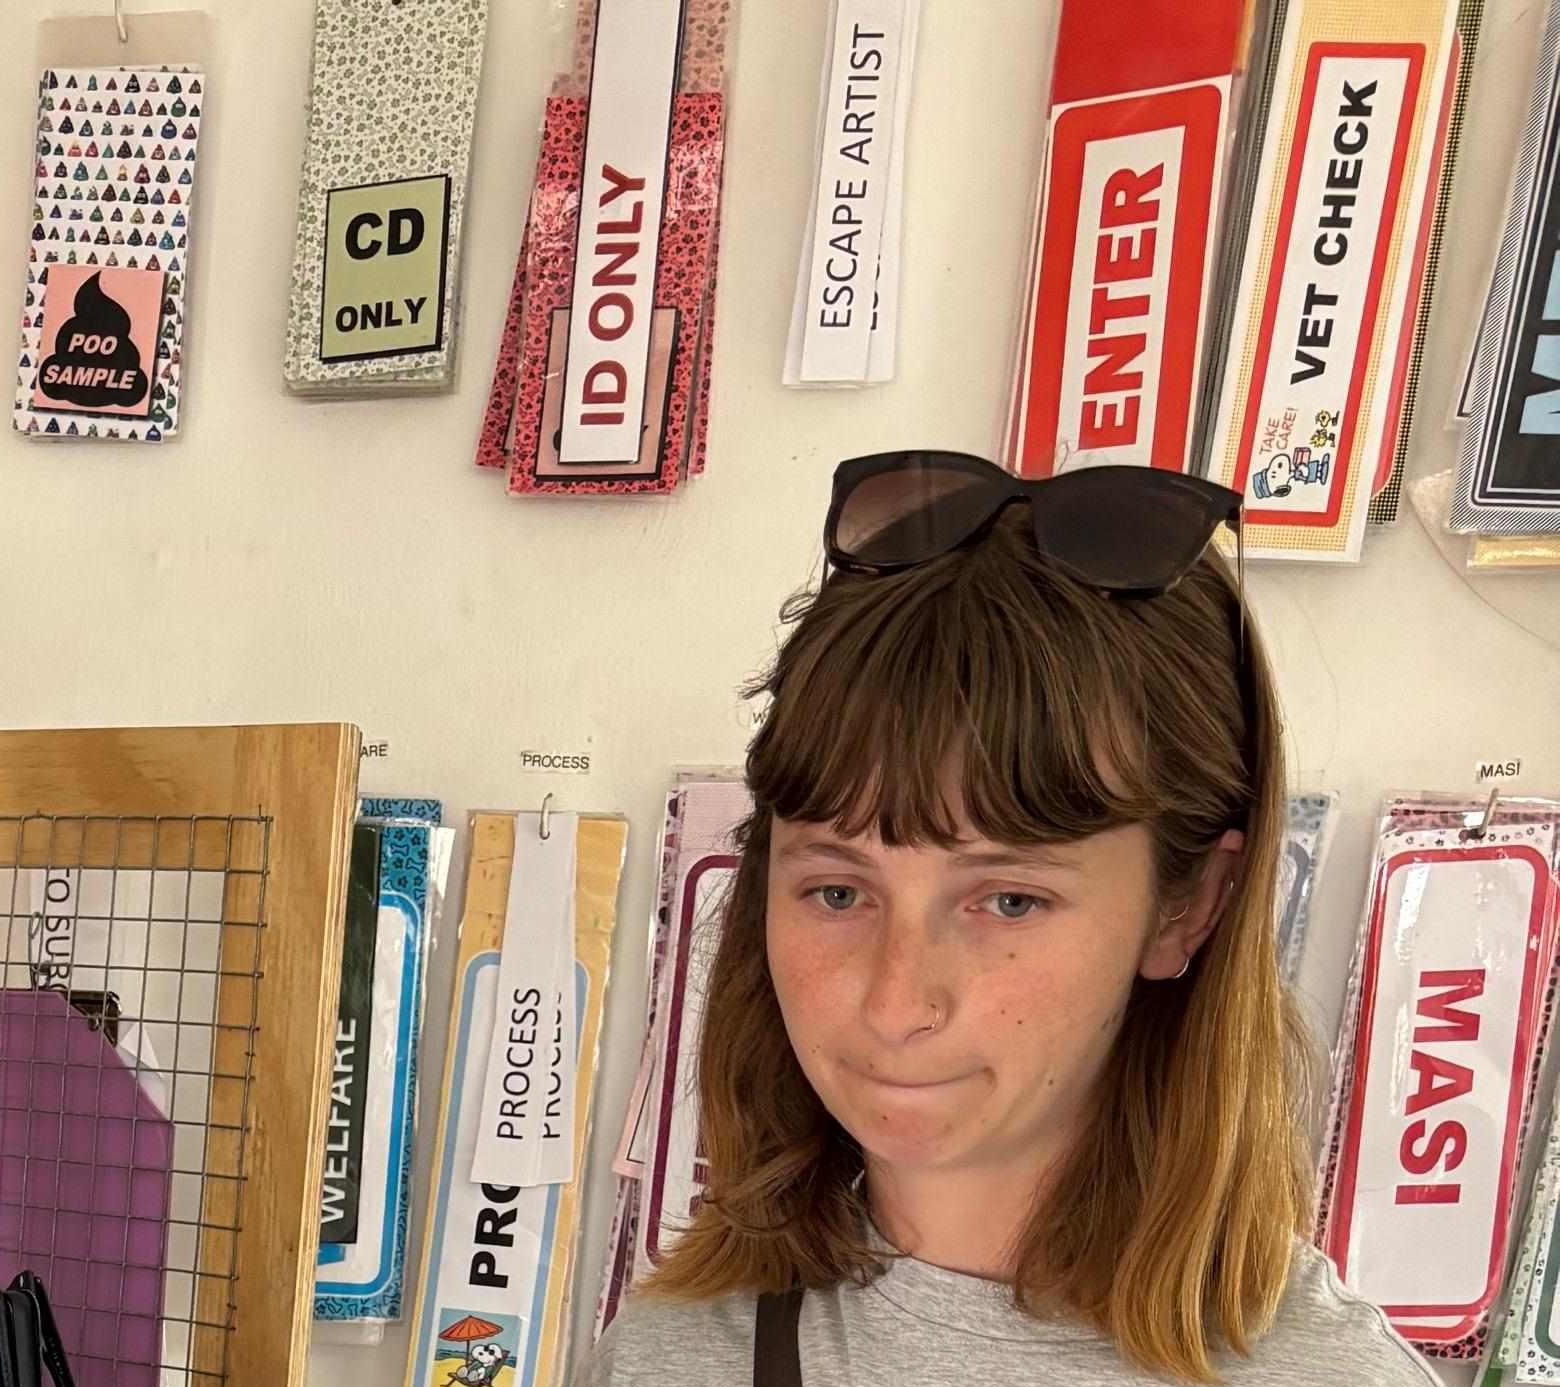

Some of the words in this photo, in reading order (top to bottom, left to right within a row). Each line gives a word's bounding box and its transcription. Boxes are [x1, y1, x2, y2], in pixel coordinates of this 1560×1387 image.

[839, 23, 886, 166] ARTIST
[1313, 79, 1378, 266] CHECK
[345, 207, 425, 261] CD
[588, 163, 646, 342] ONLY
[819, 180, 867, 329] ESCAPE
[336, 297, 427, 333] ONLY
[1078, 162, 1164, 451] ENTER
[1290, 283, 1338, 385] VET
[43, 364, 137, 390] SAMPLE
[68, 333, 118, 355] POO
[580, 359, 629, 425] ID
[1259, 417, 1280, 455] TAKE
[1276, 407, 1299, 450] CARE!
[522, 753, 590, 770] PROCESS
[1480, 762, 1521, 779] MASI
[496, 988, 541, 1141] PROCESS
[1395, 968, 1487, 1205] MASI
